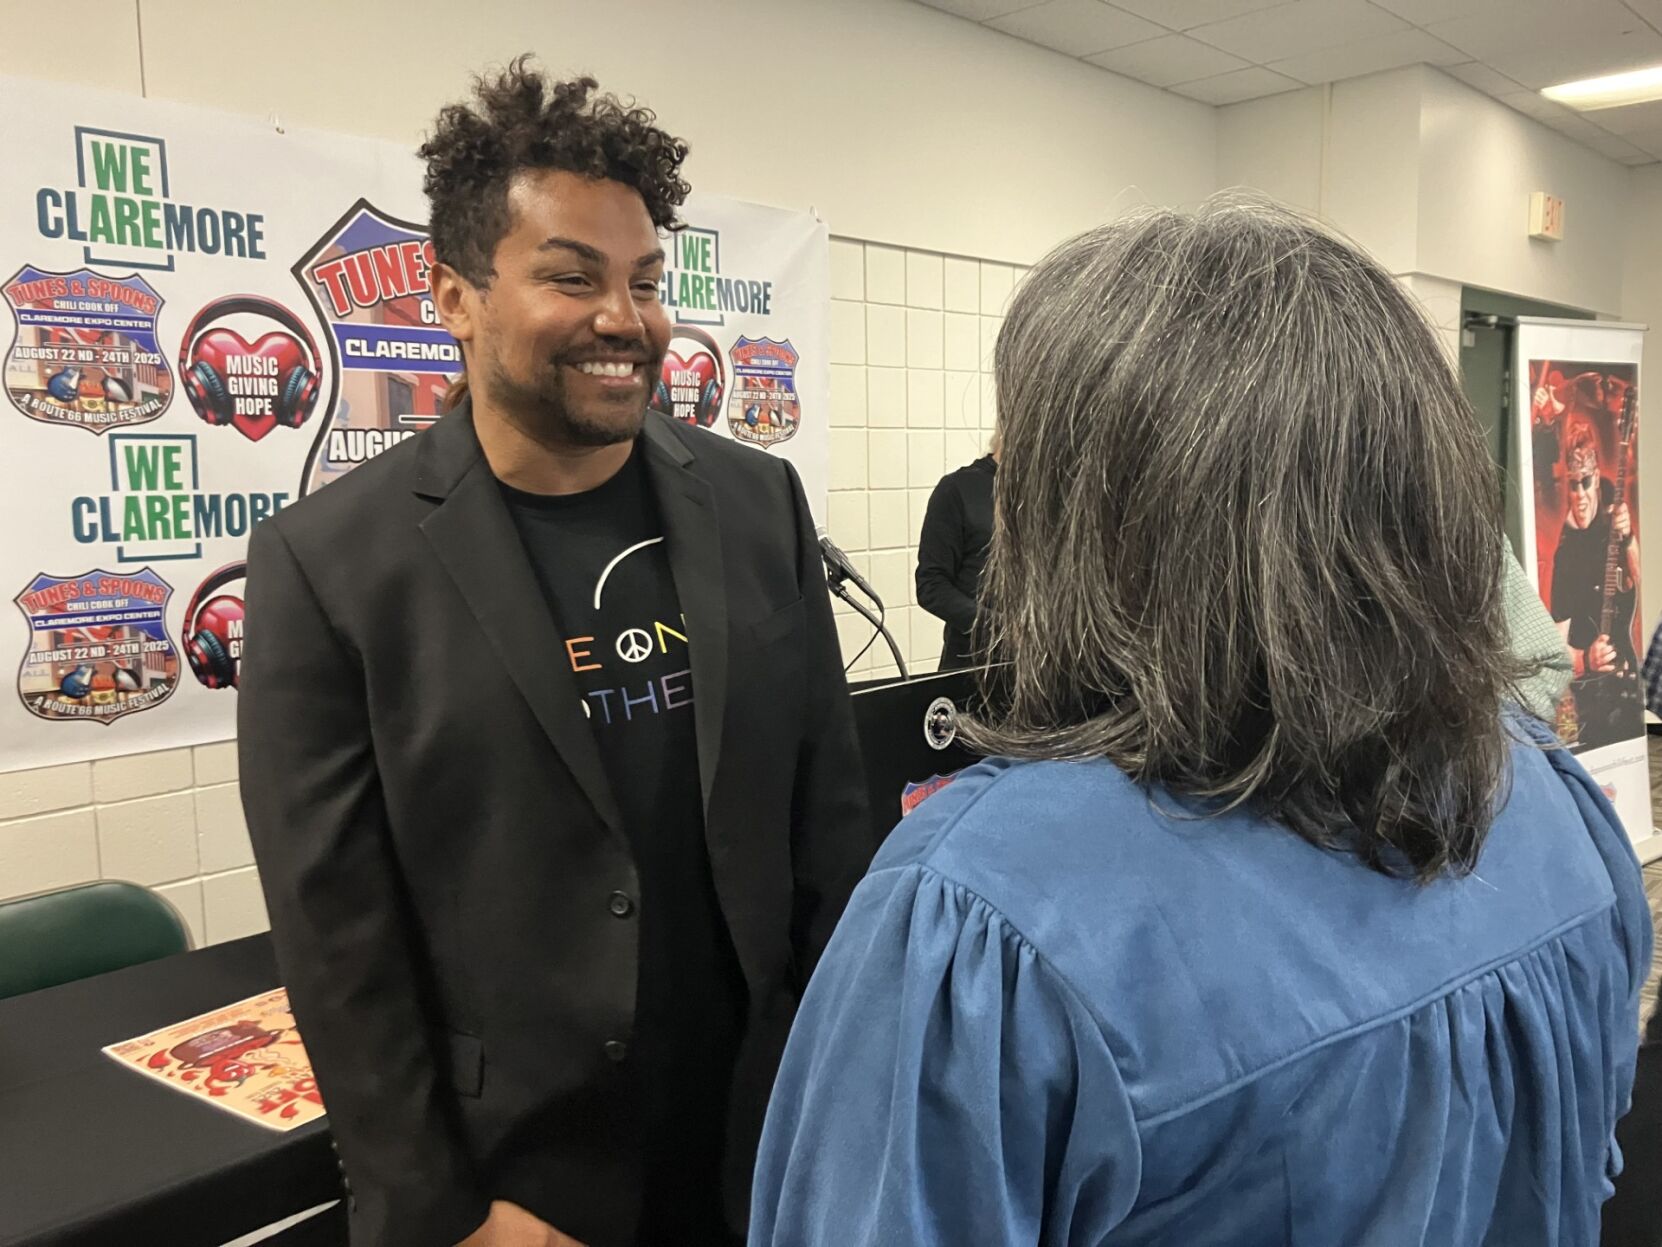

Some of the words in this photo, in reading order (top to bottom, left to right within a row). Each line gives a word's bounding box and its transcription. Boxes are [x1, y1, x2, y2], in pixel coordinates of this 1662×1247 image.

[90, 140, 153, 196] WE
[36, 188, 266, 260] CLAREMORE
[682, 233, 711, 273] WE
[7, 277, 67, 306] TUNES
[71, 279, 85, 297] &
[88, 278, 156, 315] SPOONS
[53, 300, 77, 310] CHILI
[78, 301, 102, 312] COOK
[105, 302, 119, 313] OFF
[20, 314, 83, 324] CLAREMORE
[84, 316, 111, 325] EXPO
[114, 318, 152, 328] CENTER
[15, 347, 58, 360] AUGUST
[61, 349, 76, 360] 22
[78, 350, 94, 361] ND
[102, 350, 130, 363] 24TH
[133, 352, 162, 365] 2025
[226, 355, 279, 376] MUSIC
[228, 376, 278, 396] GIVING
[671, 370, 701, 387] MUSIC
[671, 387, 700, 403] GIVING
[21, 393, 31, 404] A
[31, 397, 67, 419] ROUTE
[84, 411, 117, 424] MUSIC
[119, 399, 163, 420] FESTIVAL
[235, 398, 272, 416] HOPE
[673, 404, 696, 418] HOPE
[329, 430, 415, 462] AUGU
[124, 445, 183, 491] WE
[22, 580, 80, 614] TUNES
[83, 581, 96, 596] &
[98, 577, 166, 605] SPOONS
[66, 601, 89, 611] CHILI
[90, 600, 114, 610] COOK
[115, 598, 129, 608] OFF
[35, 616, 95, 627] CLAREMORE
[96, 613, 122, 622] EXPO
[124, 611, 160, 620] CENTER
[30, 650, 72, 664] AUGUST
[75, 648, 89, 659] 22
[91, 646, 106, 657] ND
[113, 643, 139, 655] 24TH
[143, 640, 170, 652] 2025
[34, 696, 44, 705] A
[94, 702, 127, 715] MUSIC
[128, 683, 170, 708] FESTIVAL
